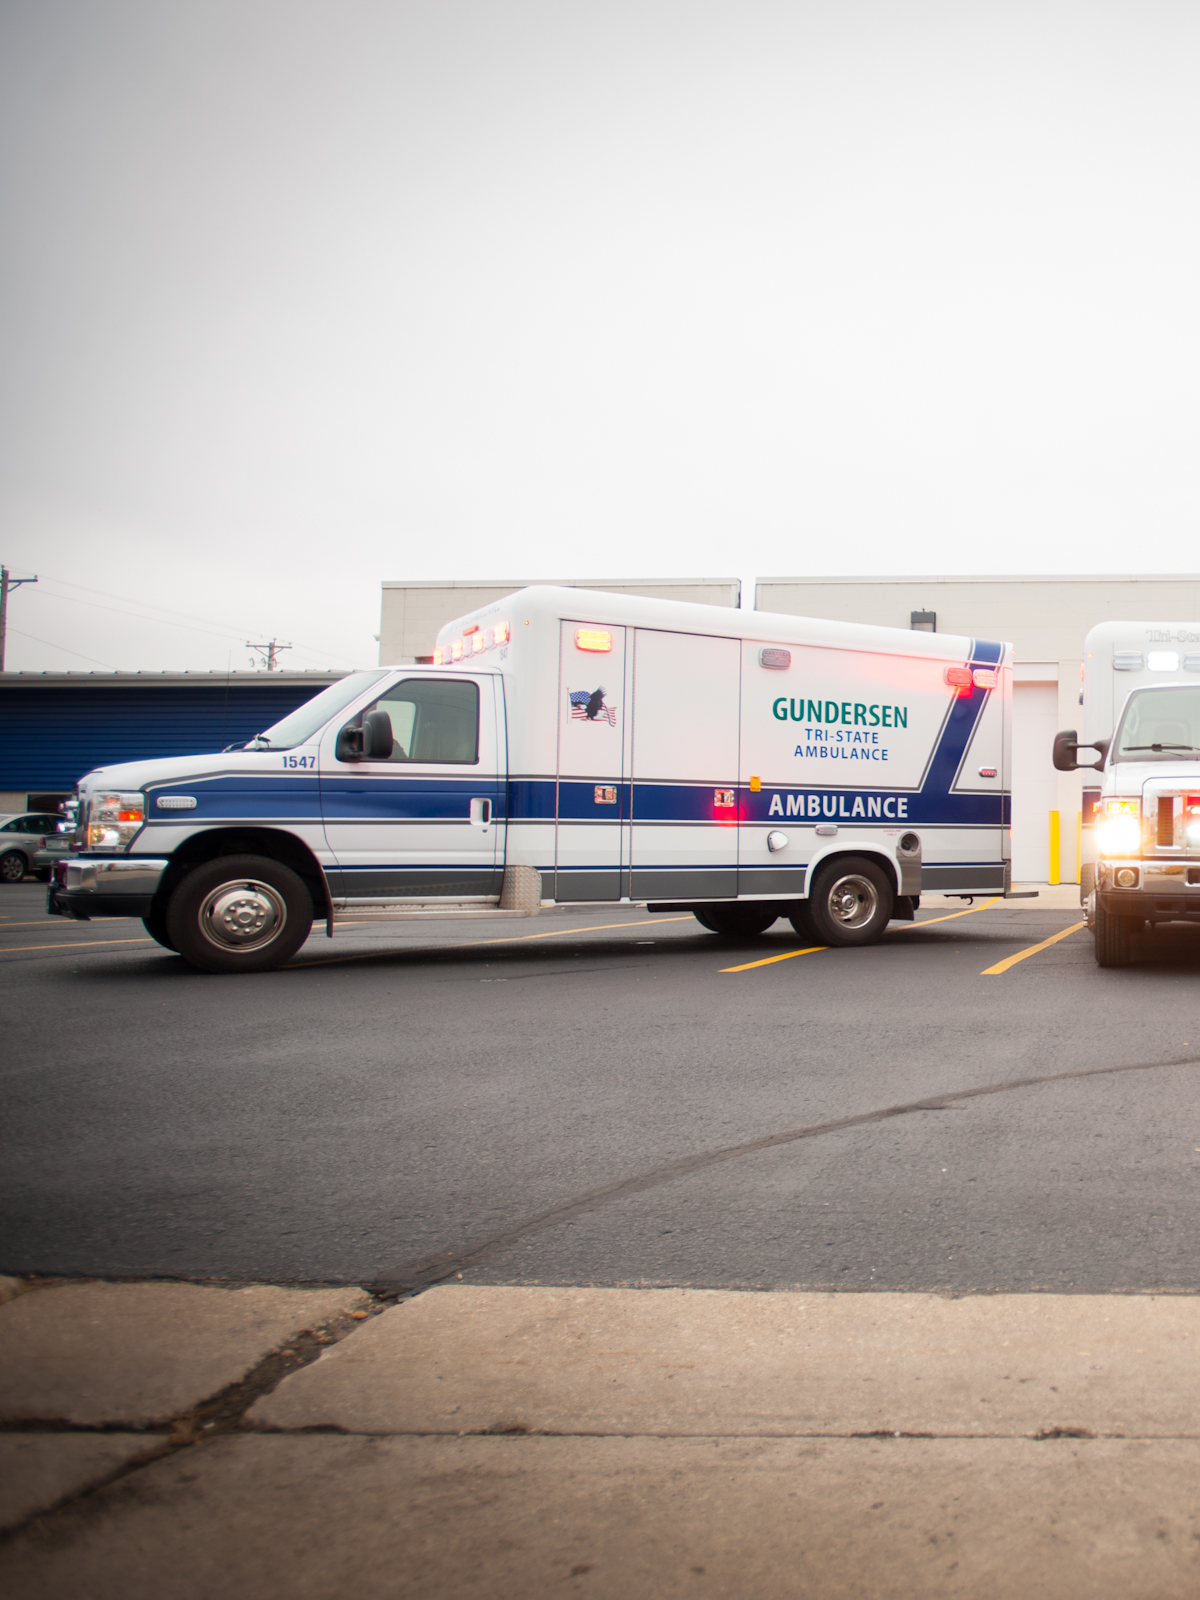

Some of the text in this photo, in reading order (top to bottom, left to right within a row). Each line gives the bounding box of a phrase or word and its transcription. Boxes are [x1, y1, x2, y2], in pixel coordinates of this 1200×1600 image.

[772, 697, 908, 729] GUNDERSEN
[804, 728, 879, 744] TRI-STATE
[794, 745, 889, 761] AMBULANCE
[282, 755, 316, 769] 1547
[768, 793, 909, 819] AMBULANCE
